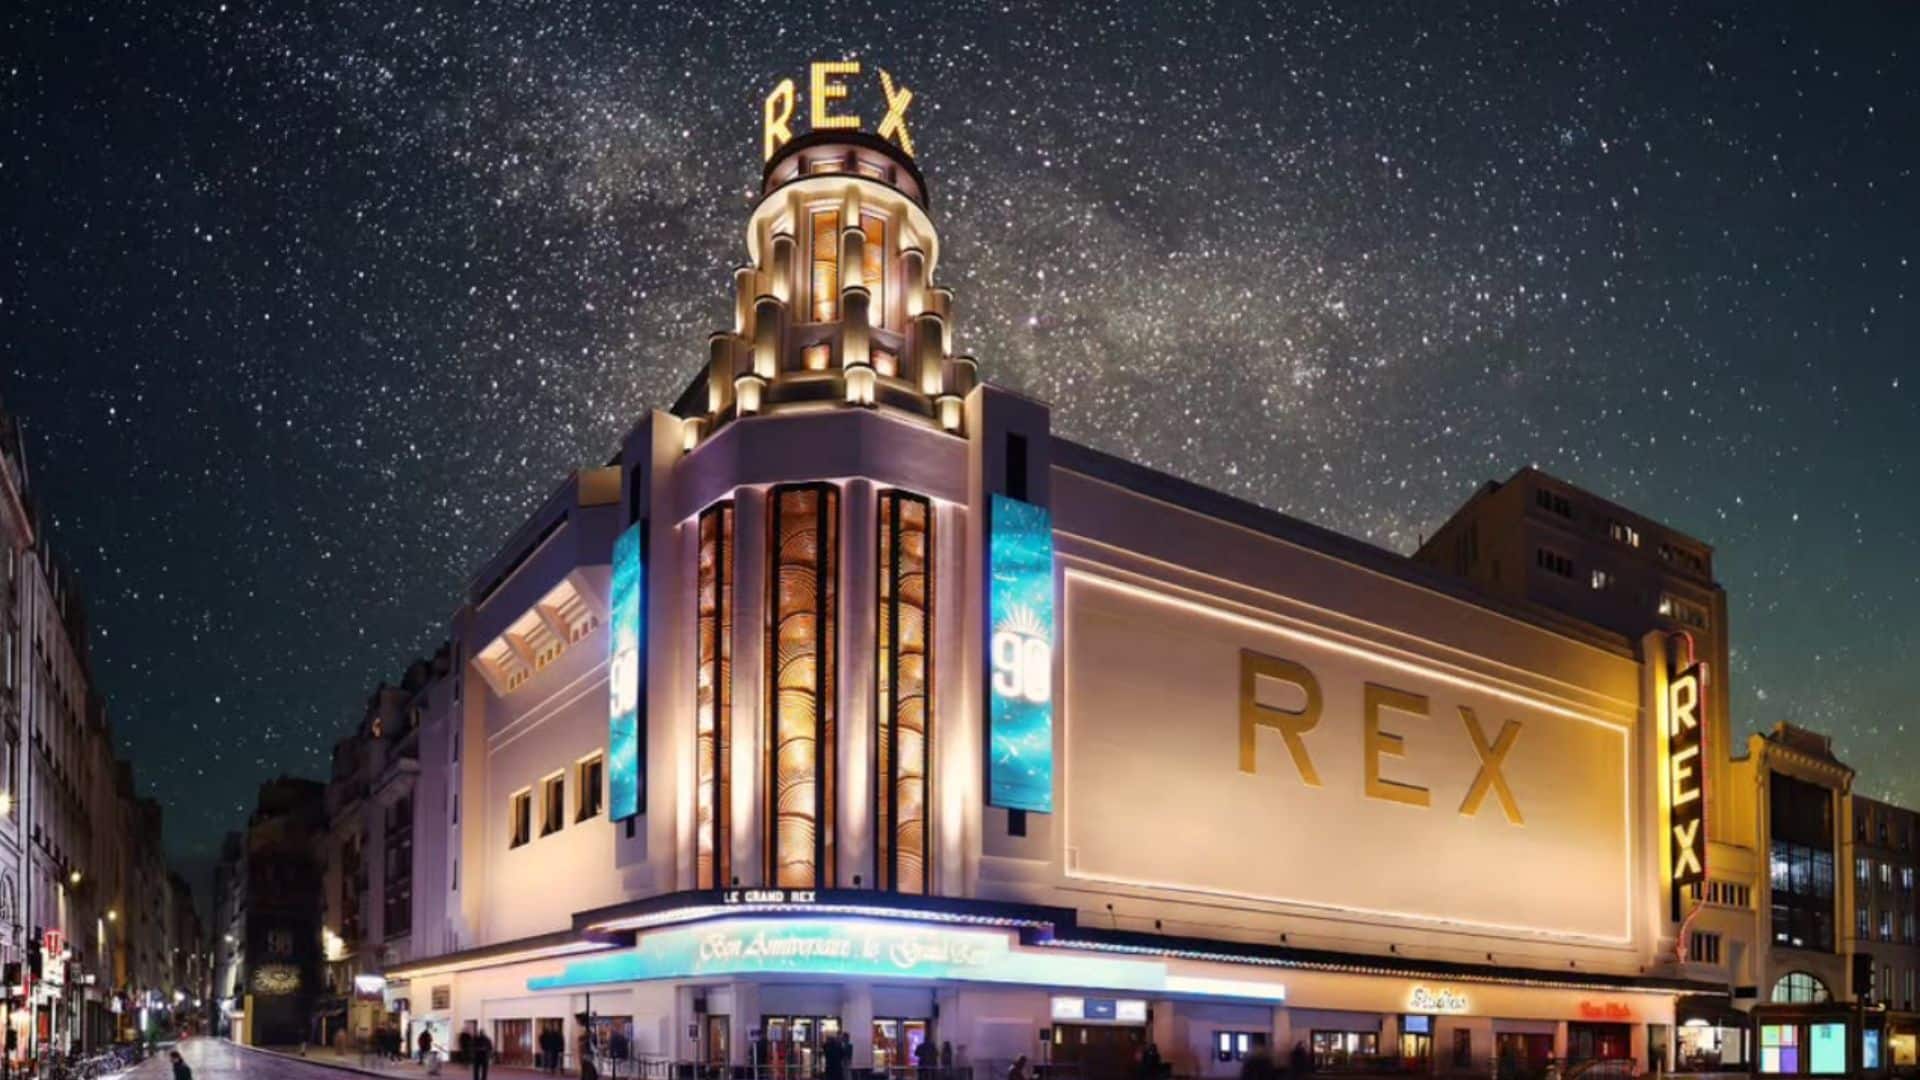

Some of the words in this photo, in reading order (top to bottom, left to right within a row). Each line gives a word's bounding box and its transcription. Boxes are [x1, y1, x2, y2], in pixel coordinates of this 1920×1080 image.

[765, 61, 915, 162] REX
[992, 631, 1052, 704] 90
[1239, 647, 1525, 827] REX
[1670, 675, 1702, 879] REX
[724, 890, 739, 903] LE
[745, 890, 784, 903] GRAND
[791, 890, 816, 903] REX
